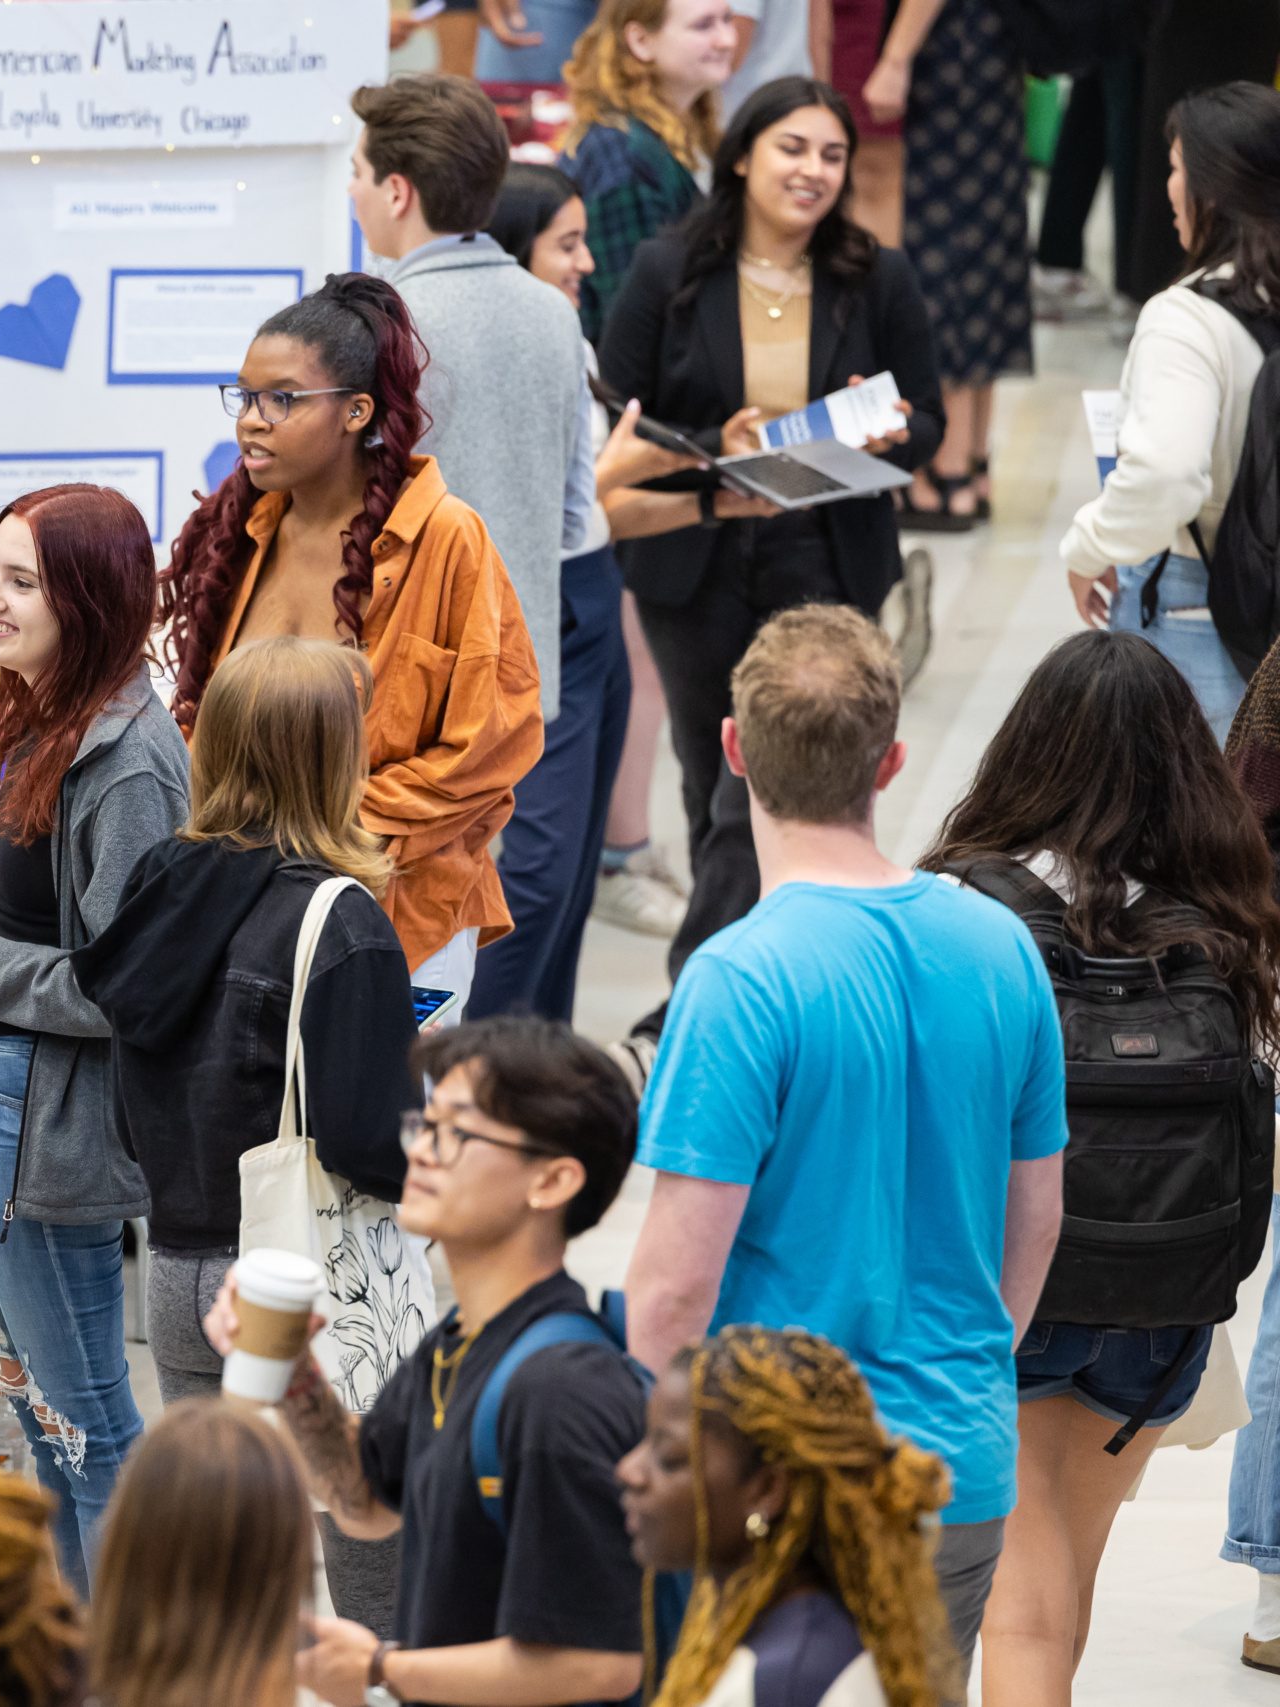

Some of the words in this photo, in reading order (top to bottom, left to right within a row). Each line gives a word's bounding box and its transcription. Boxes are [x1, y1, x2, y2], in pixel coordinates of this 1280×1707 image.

[207, 20, 326, 76] Association
[77, 99, 162, 137] University
[180, 105, 250, 139] Chicago
[150, 202, 218, 215] Welcome
